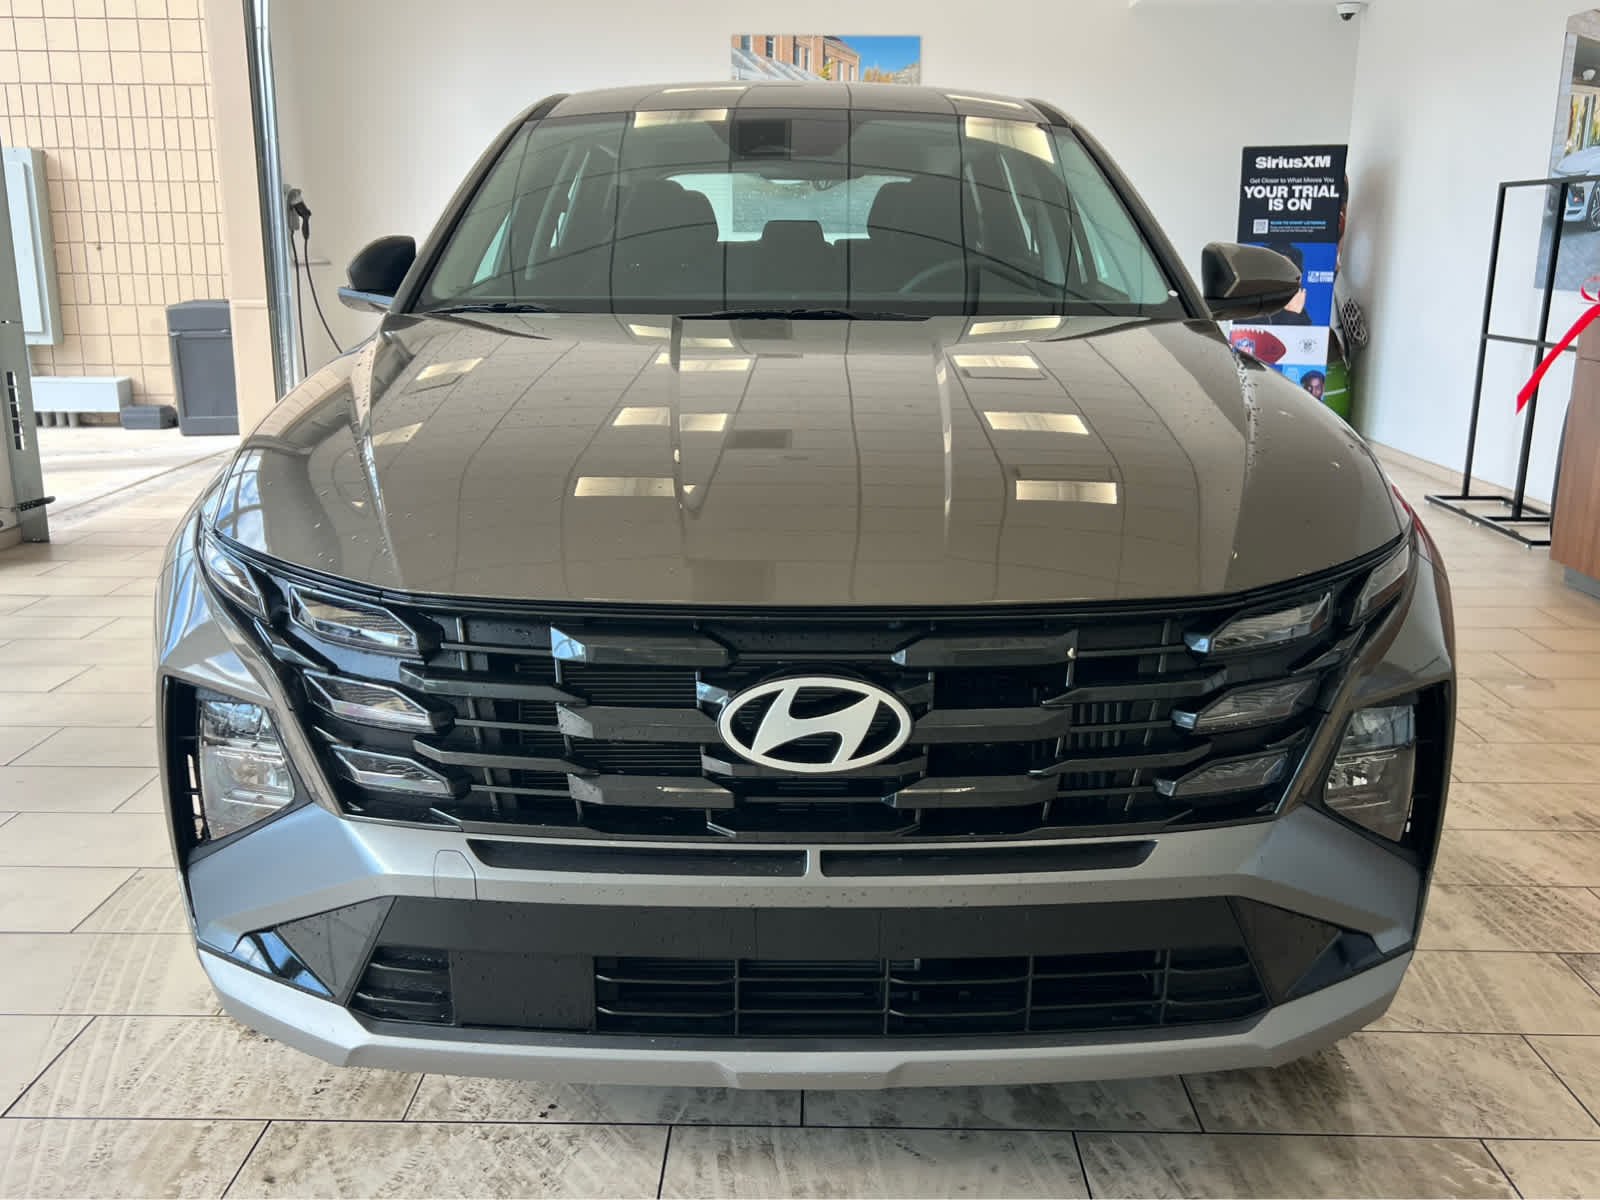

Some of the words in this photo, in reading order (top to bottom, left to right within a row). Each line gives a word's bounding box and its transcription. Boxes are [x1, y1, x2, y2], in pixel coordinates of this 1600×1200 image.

[1255, 155, 1331, 169] SiriusXM
[1244, 185, 1288, 199] YOUR
[1291, 184, 1339, 198] TRIAL
[1268, 198, 1284, 211] IS
[1287, 198, 1312, 211] ON
